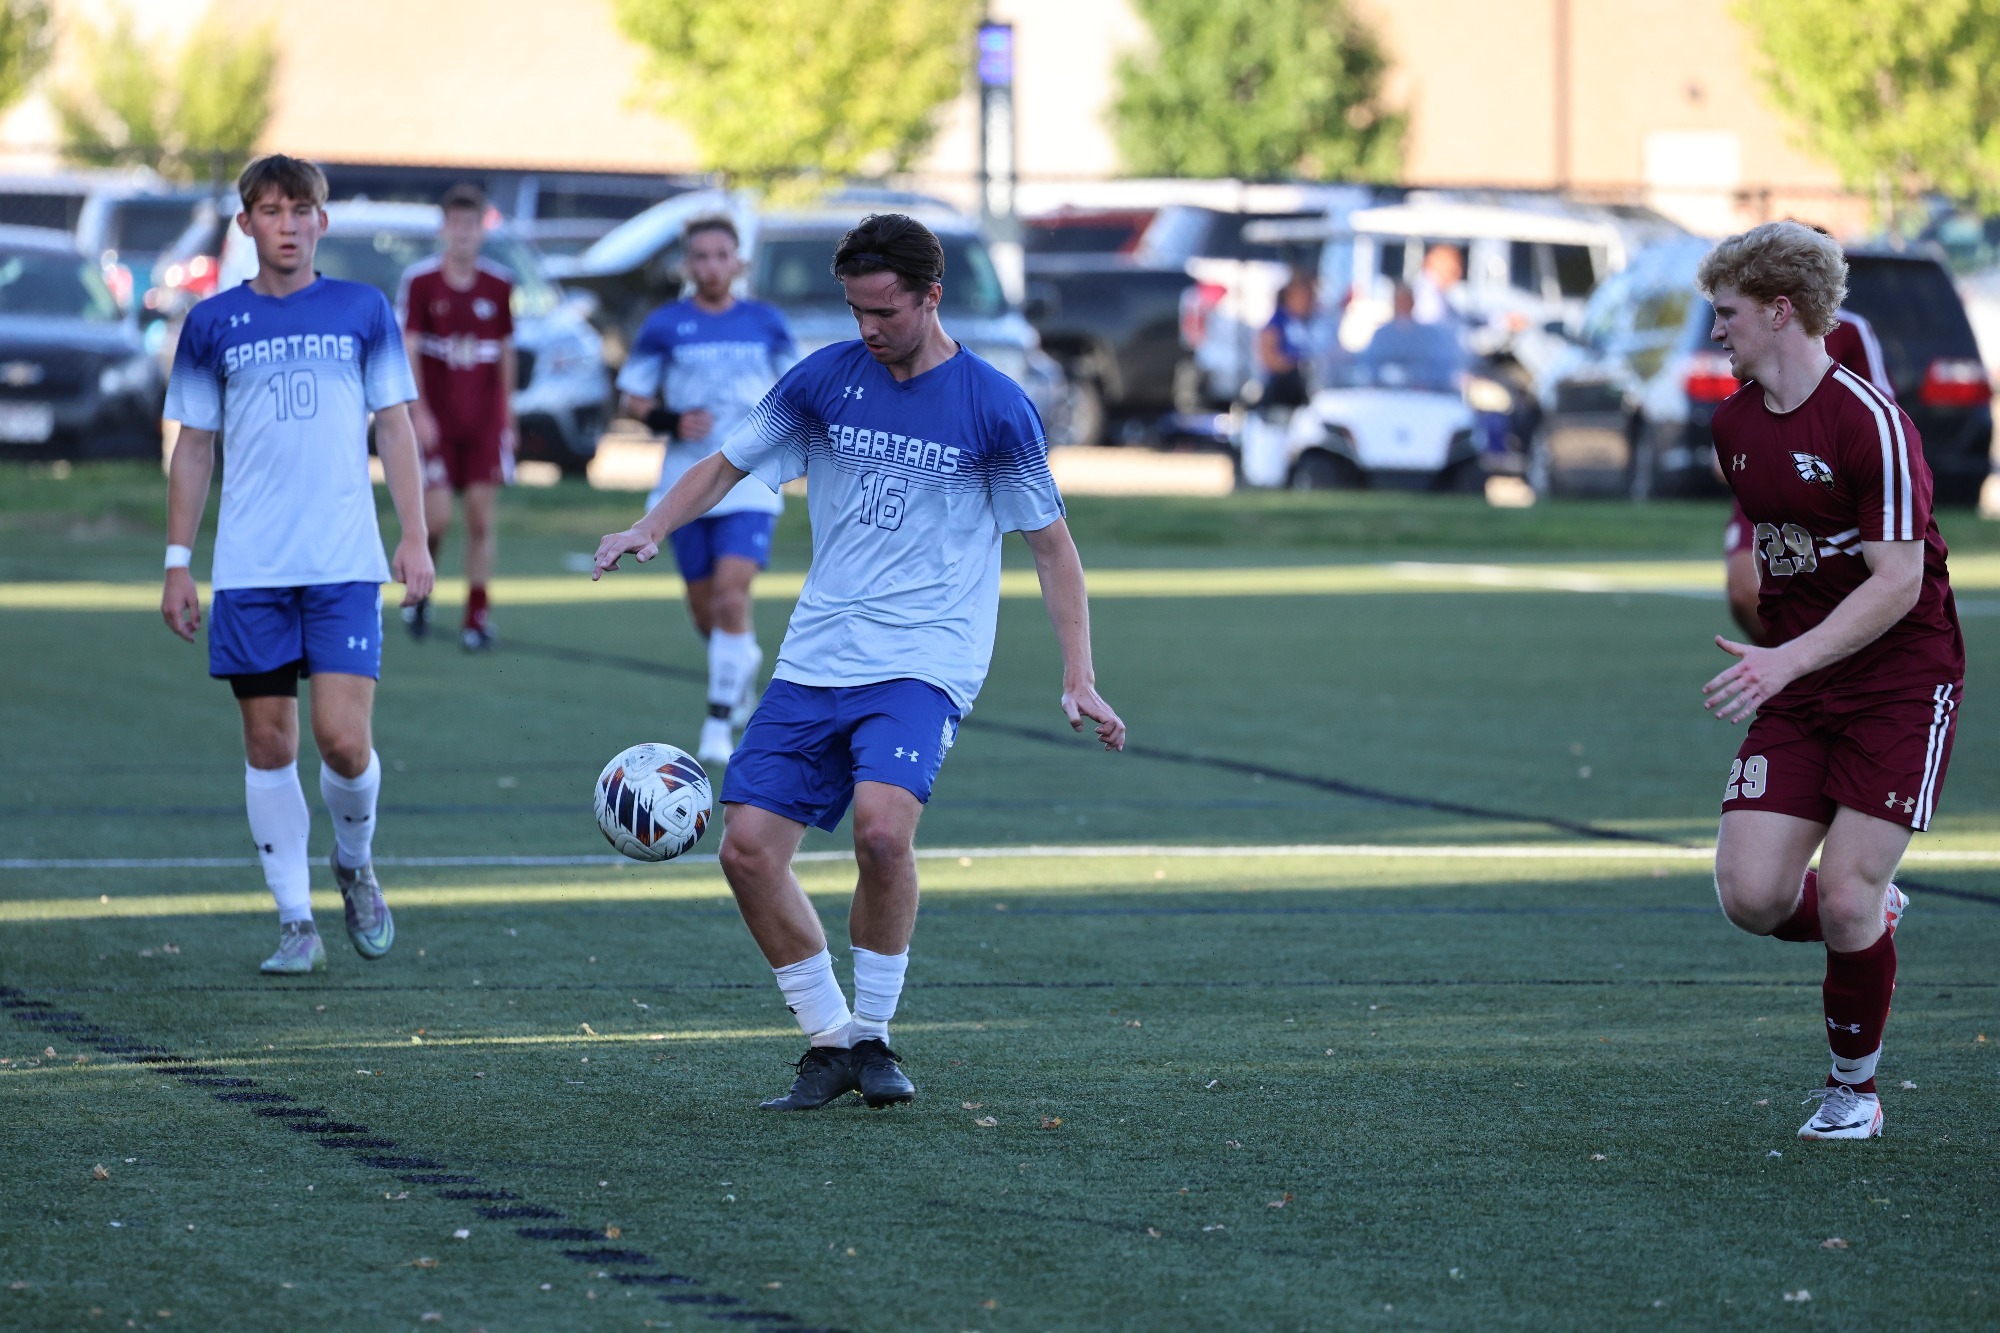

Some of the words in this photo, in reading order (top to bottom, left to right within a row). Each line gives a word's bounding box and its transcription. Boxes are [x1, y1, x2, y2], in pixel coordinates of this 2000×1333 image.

[225, 334, 354, 372] SPARTANS
[267, 368, 318, 422] 10
[827, 424, 961, 475] SPARTANS
[860, 470, 909, 532] 16
[1756, 522, 1818, 577] 29
[1723, 754, 1768, 803] 29
